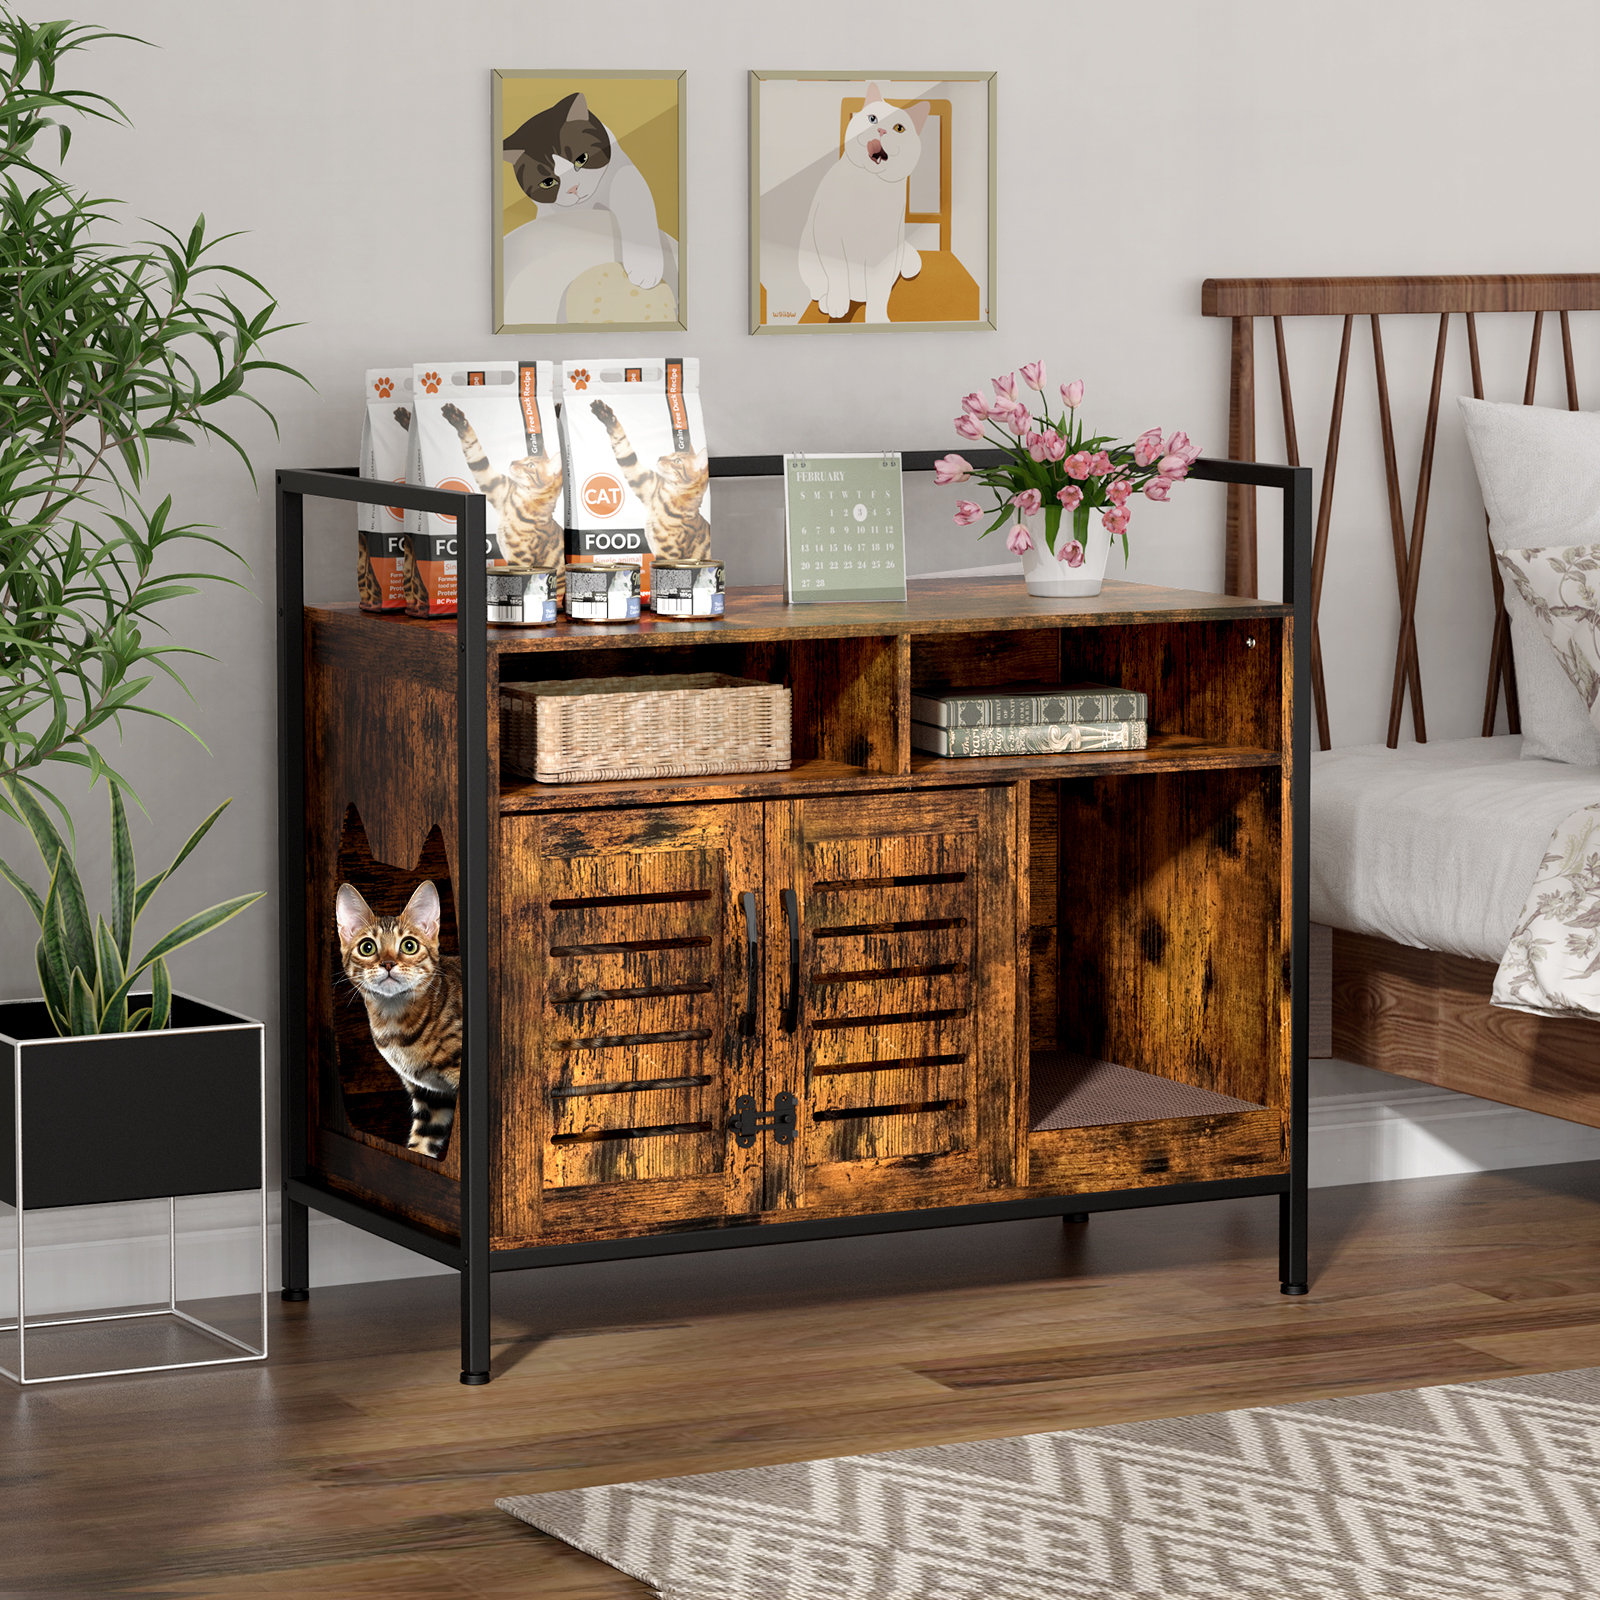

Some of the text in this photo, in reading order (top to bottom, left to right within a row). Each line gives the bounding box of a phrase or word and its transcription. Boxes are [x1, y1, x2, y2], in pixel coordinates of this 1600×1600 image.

[526, 397, 534, 414] Duck
[796, 472, 845, 482] FEBRUARY
[584, 488, 620, 504] CAT
[814, 491, 820, 499] M
[586, 534, 640, 550] FOOD
